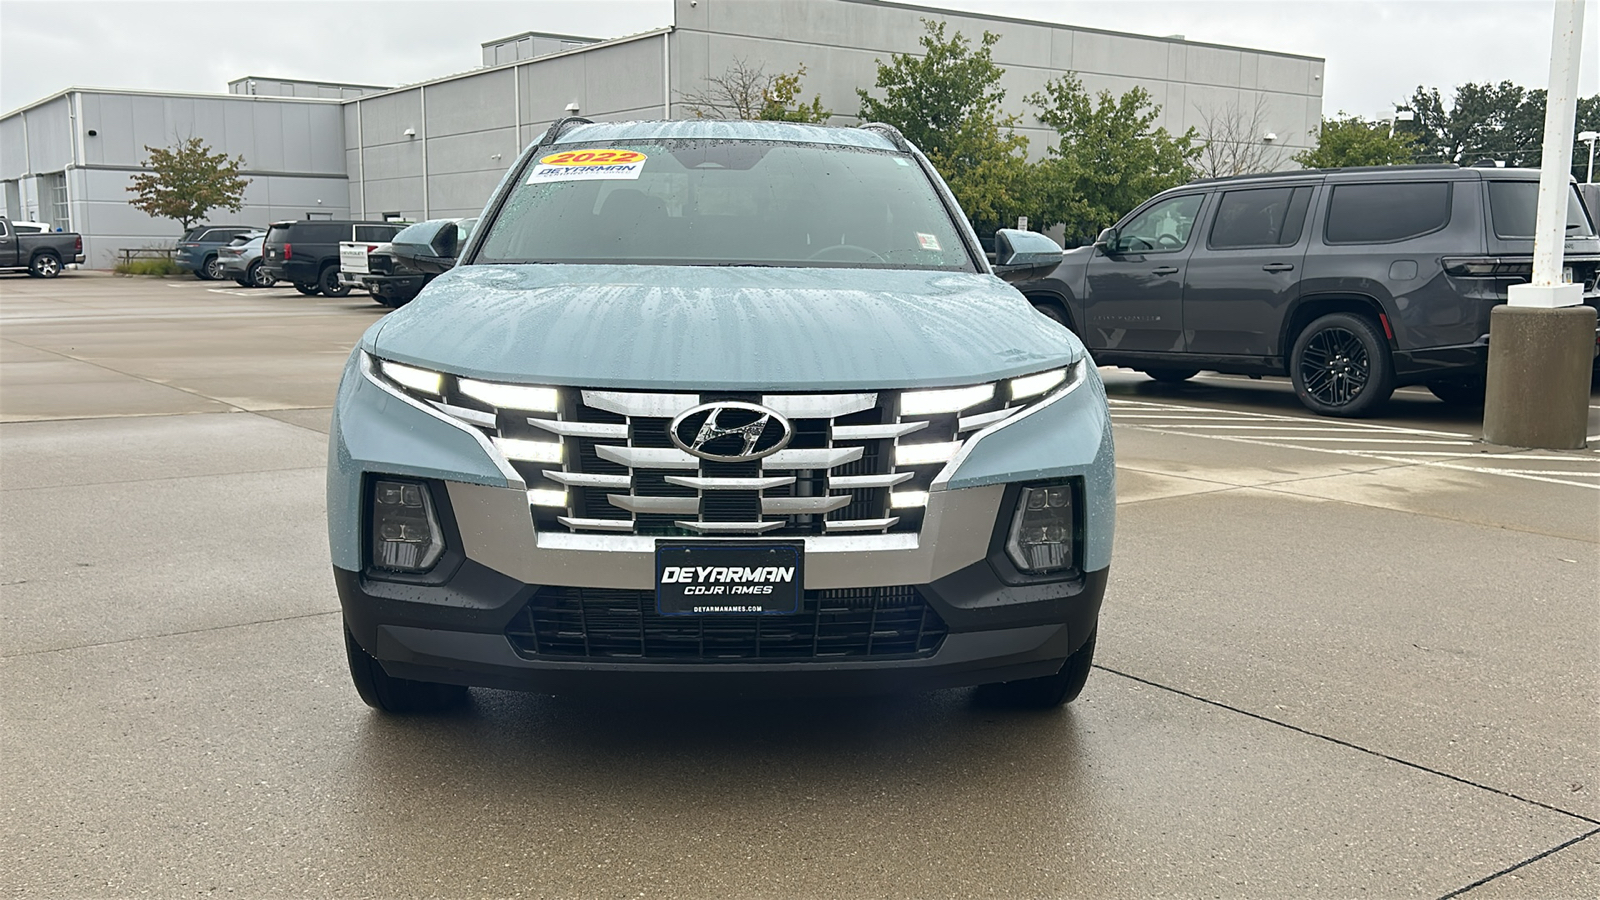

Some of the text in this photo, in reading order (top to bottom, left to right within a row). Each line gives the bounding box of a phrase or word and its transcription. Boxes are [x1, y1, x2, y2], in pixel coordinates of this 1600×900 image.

[550, 152, 639, 163] 2022
[538, 165, 637, 175] DEYARMAN
[661, 566, 795, 583] DEYARMAN
[684, 585, 773, 595] CDJR AMES
